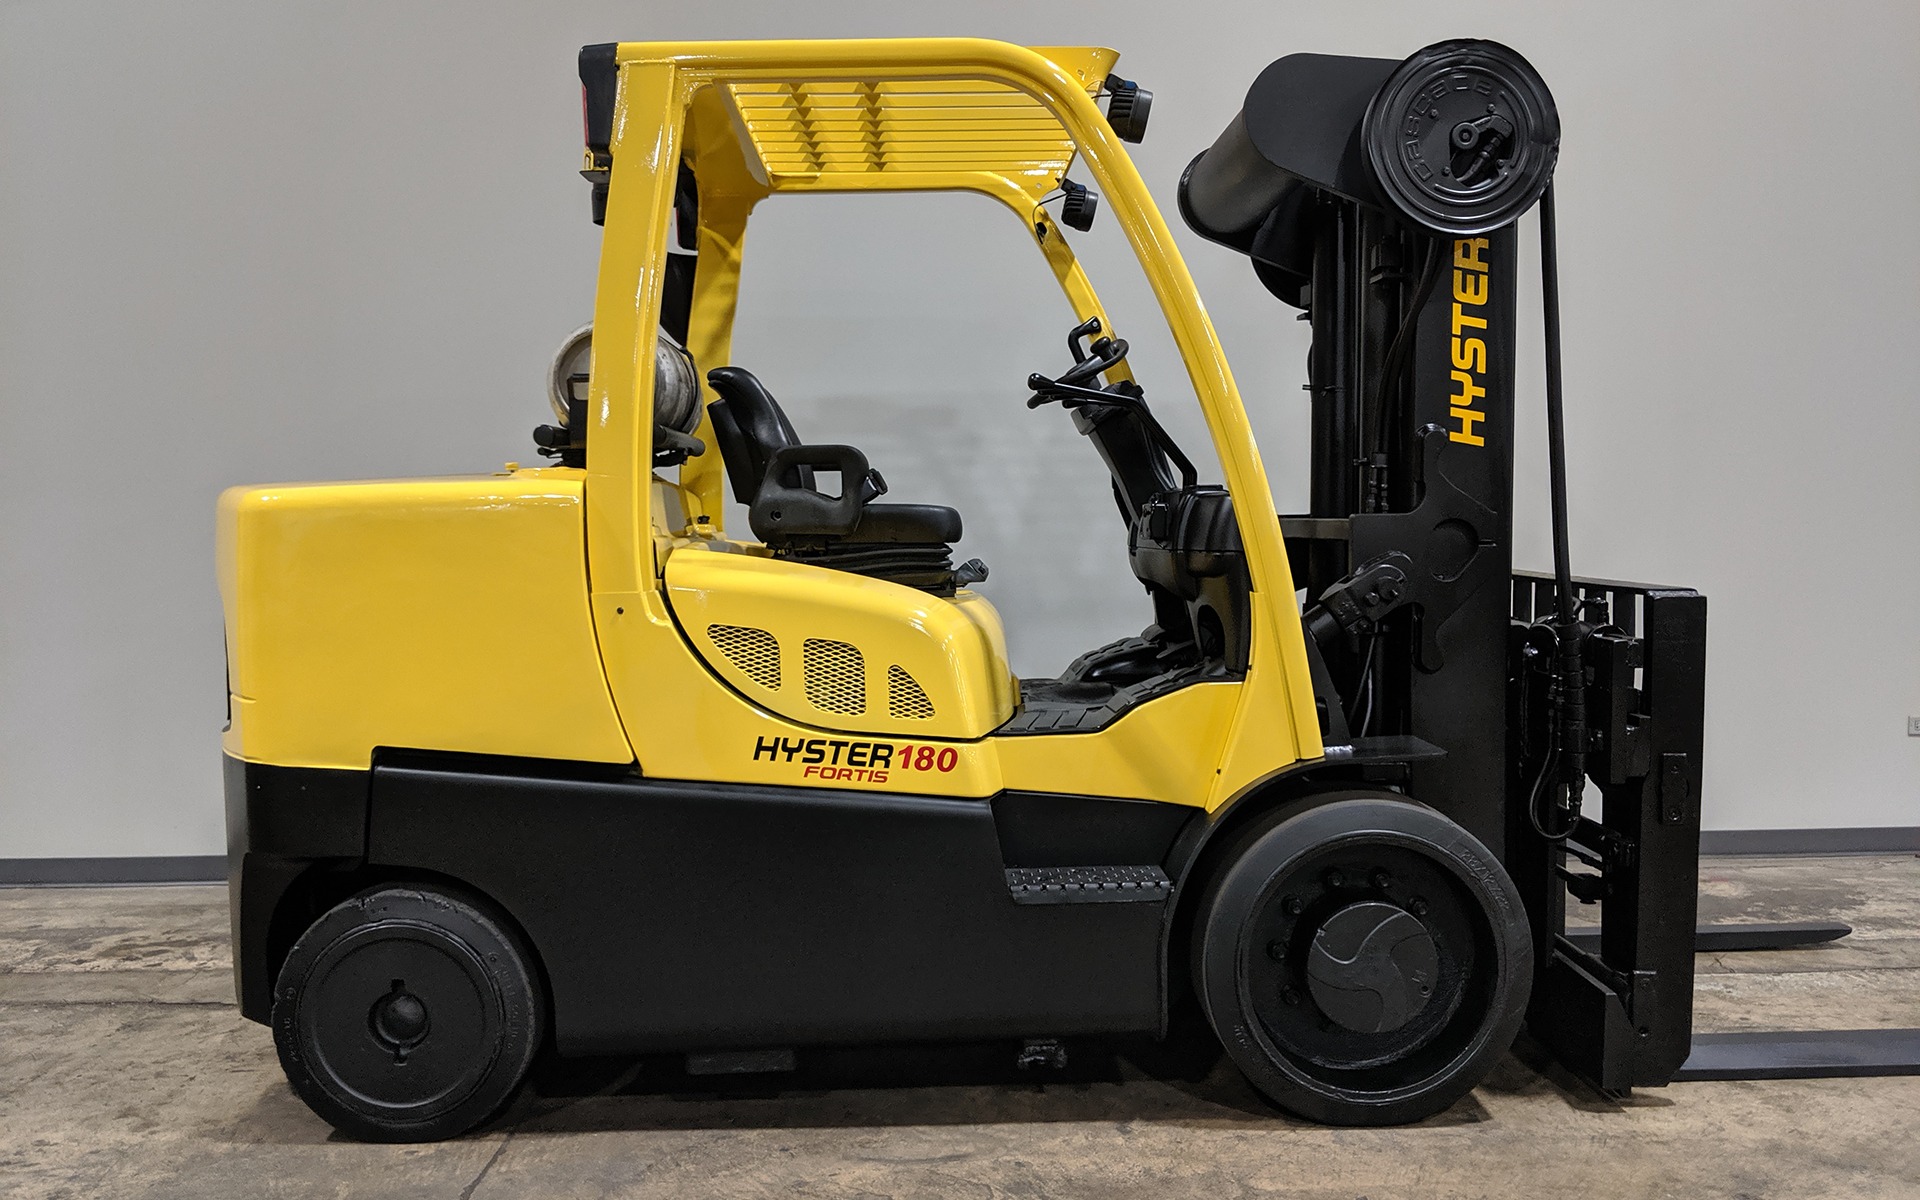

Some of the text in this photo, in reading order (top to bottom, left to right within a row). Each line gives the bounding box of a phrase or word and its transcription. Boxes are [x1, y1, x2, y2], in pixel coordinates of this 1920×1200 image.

[1406, 74, 1494, 183] CASCADE
[1449, 237, 1490, 447] HYSTER
[753, 736, 958, 772] HYSTER 180
[804, 766, 889, 783] FORTIS
